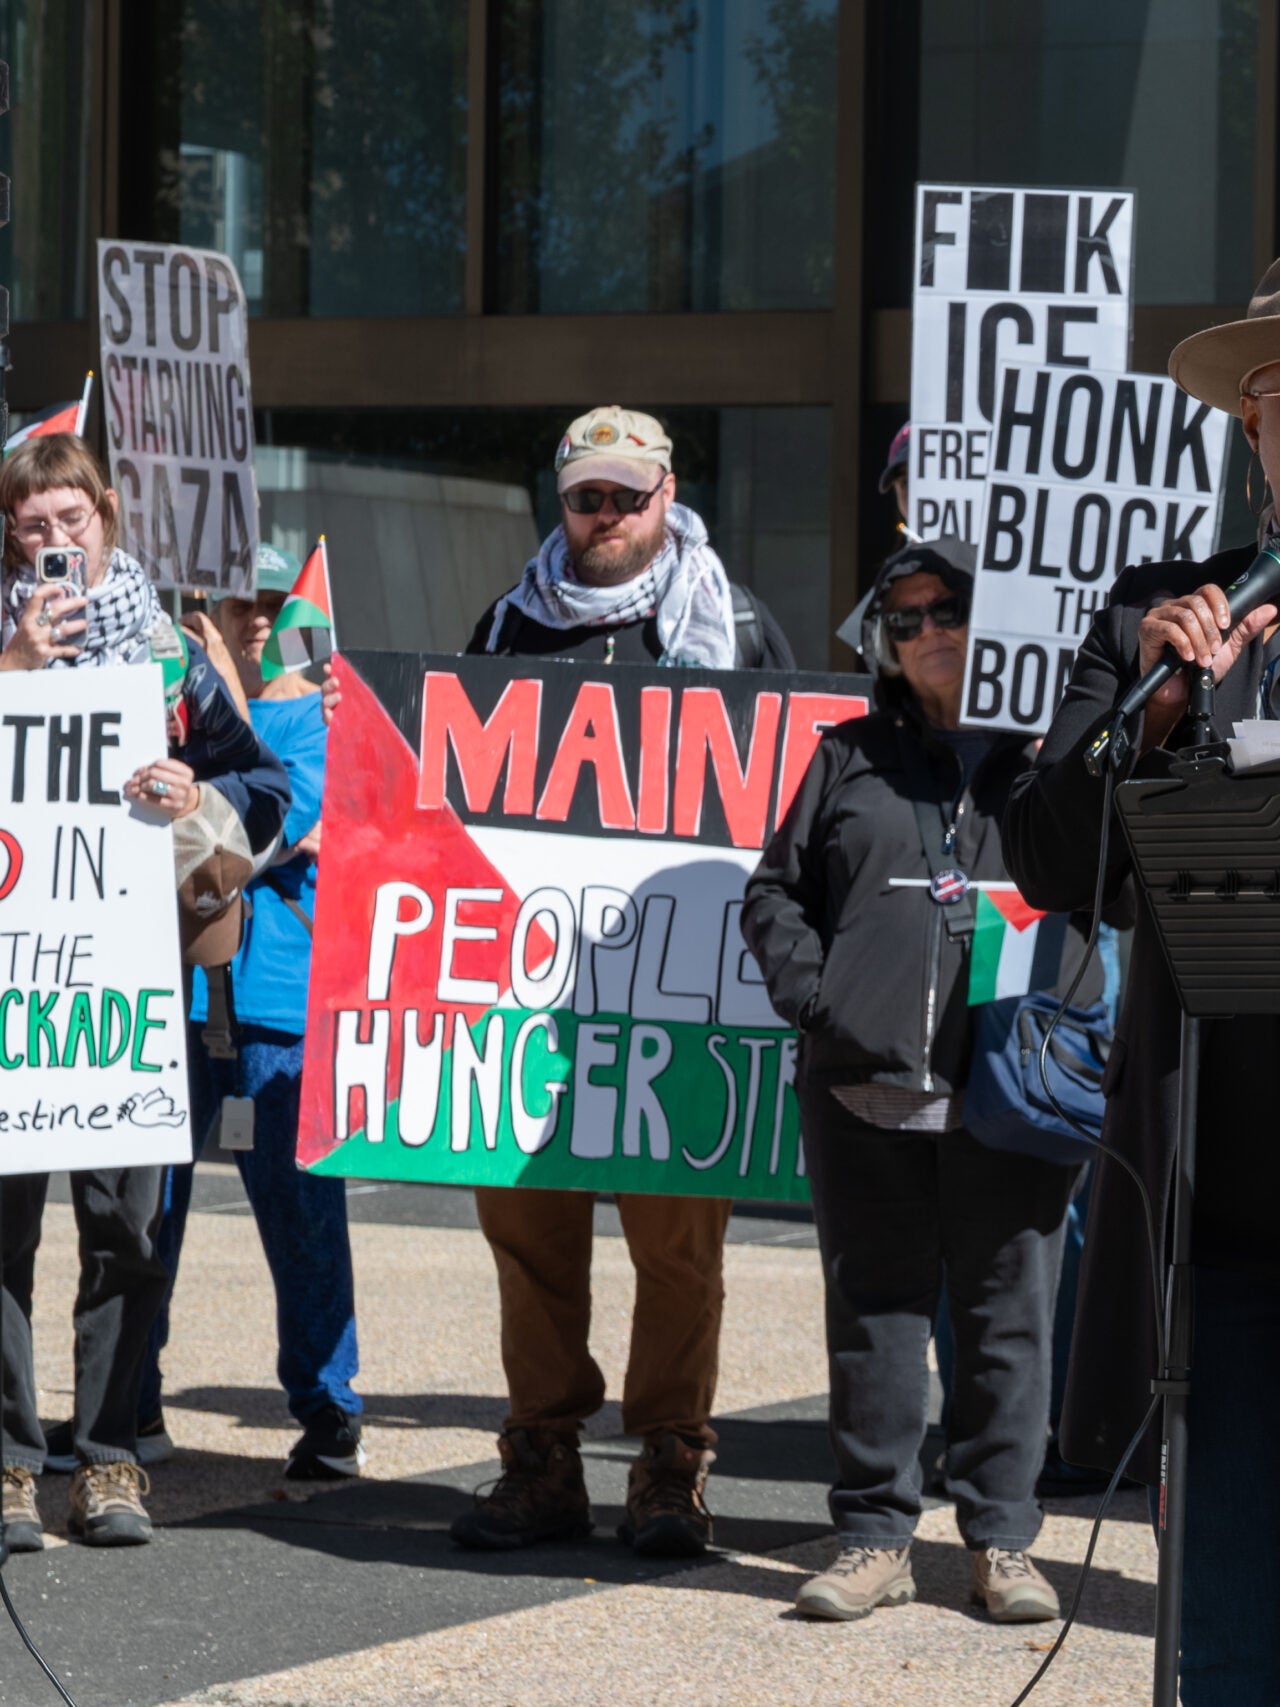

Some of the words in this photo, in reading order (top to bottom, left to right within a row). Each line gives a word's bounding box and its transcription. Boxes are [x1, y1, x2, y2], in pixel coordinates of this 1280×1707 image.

[103, 247, 240, 353] STOP
[106, 353, 248, 462] STARVING
[918, 429, 992, 479] FRE
[994, 368, 1212, 493] HONK
[116, 458, 253, 591] GAZA
[982, 483, 1208, 583] BLOCK
[1054, 586, 1110, 635] TH
[2, 712, 122, 805] THE
[52, 826, 127, 900] IN.
[0, 932, 93, 987] THE
[333, 1008, 673, 1160] HUNGER
